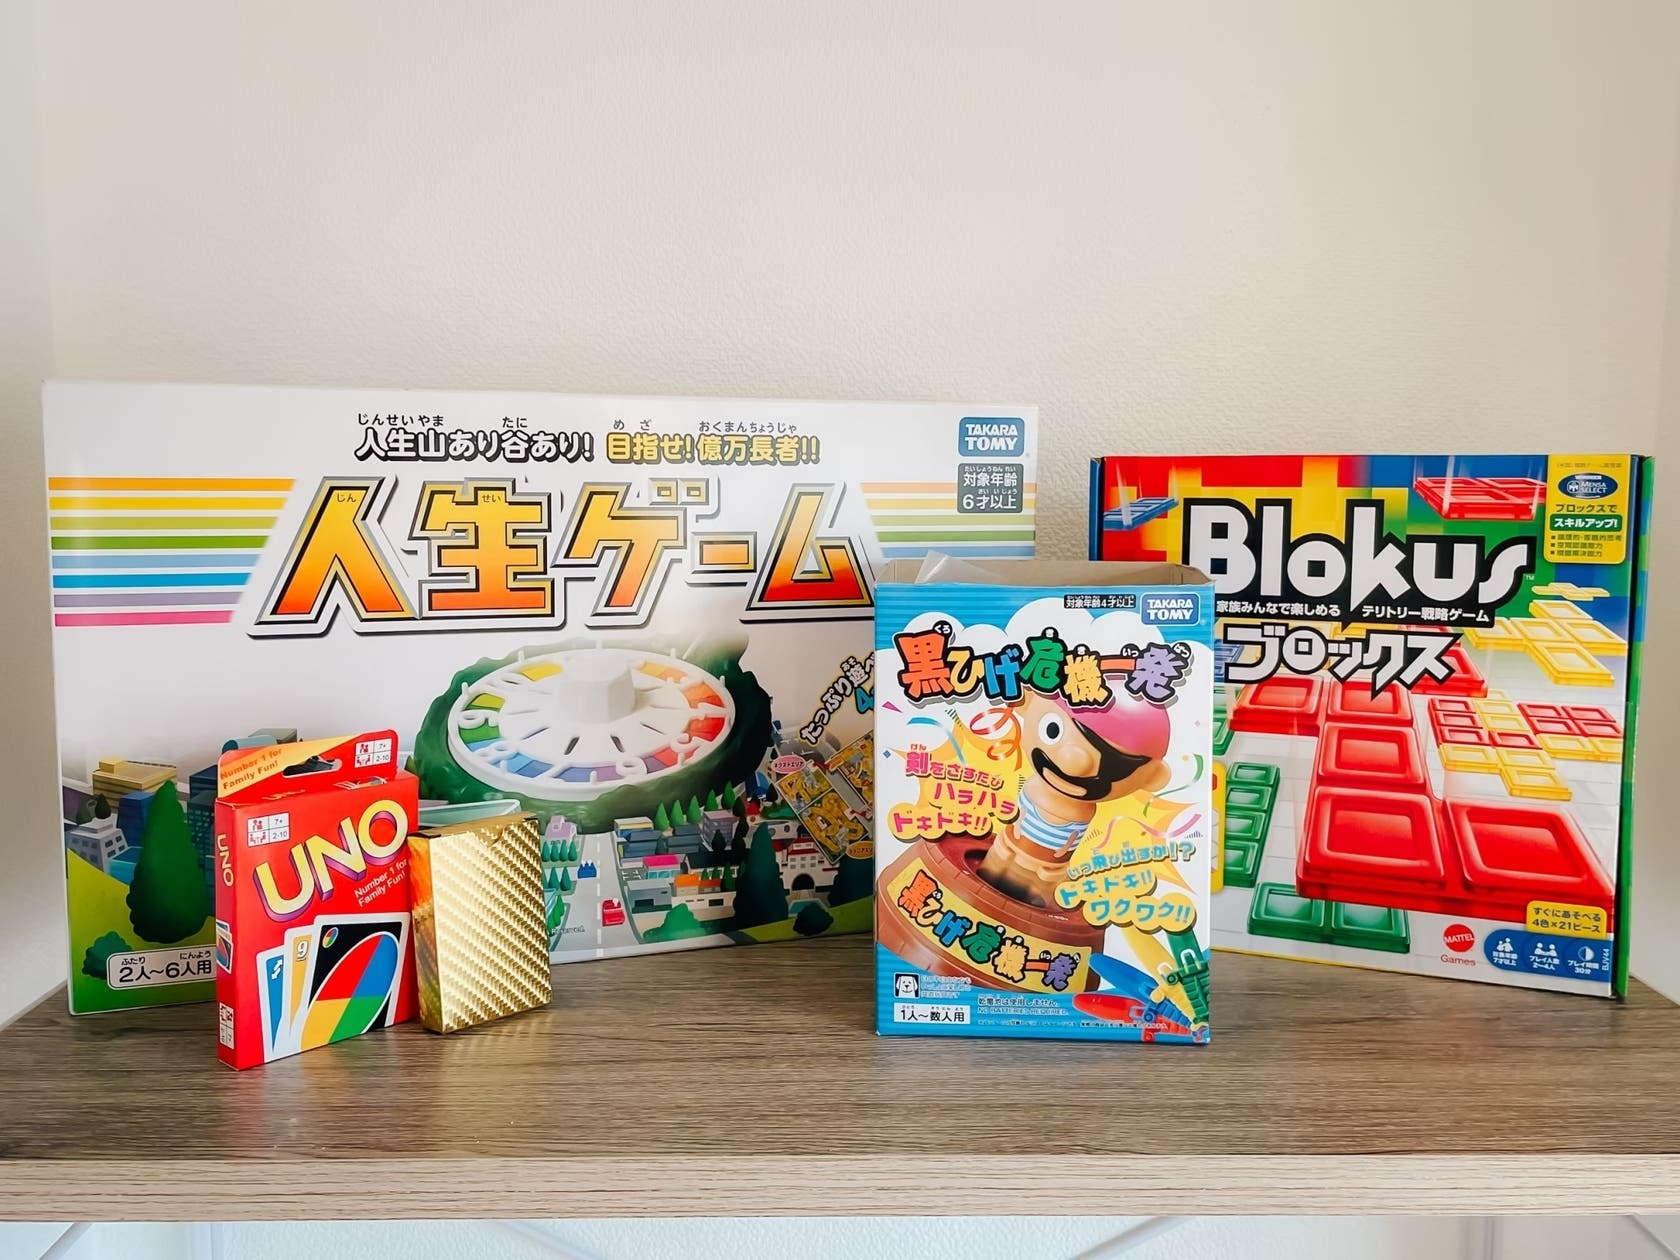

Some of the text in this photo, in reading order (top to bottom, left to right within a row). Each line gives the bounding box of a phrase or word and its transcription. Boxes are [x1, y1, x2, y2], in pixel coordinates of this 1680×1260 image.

[965, 423, 1018, 436] TAKARA
[964, 436, 1018, 451] TOMY
[963, 472, 1018, 487] 対象年齢
[962, 494, 1017, 510] 6才以上
[1555, 504, 1617, 513] ブロックスで
[258, 478, 874, 632] 人生ゲーム
[1187, 502, 1531, 610] Blokus
[1147, 599, 1193, 609] TAKARA
[1147, 609, 1193, 620] TOMY
[1216, 600, 1490, 622] 家族みんなで楽しめる テリトリー戦略ゲーム
[896, 632, 1186, 705] 黒ひげ危機一発
[1225, 622, 1461, 696] ブロックス
[220, 759, 258, 780] Number
[268, 749, 282, 758] for
[223, 760, 278, 790] Family Fun!
[934, 783, 1015, 815] ハラハラ
[217, 834, 234, 887] UNO
[253, 799, 409, 923] UNO
[354, 859, 408, 898] Number 1 for
[358, 871, 406, 908] Family Fun!
[1533, 907, 1601, 922] すぐにあそべる
[898, 869, 1077, 991] 黒ひげ危機一発
[1444, 933, 1475, 943] MATTEL
[297, 941, 309, 961] 9
[1440, 954, 1476, 966] Games
